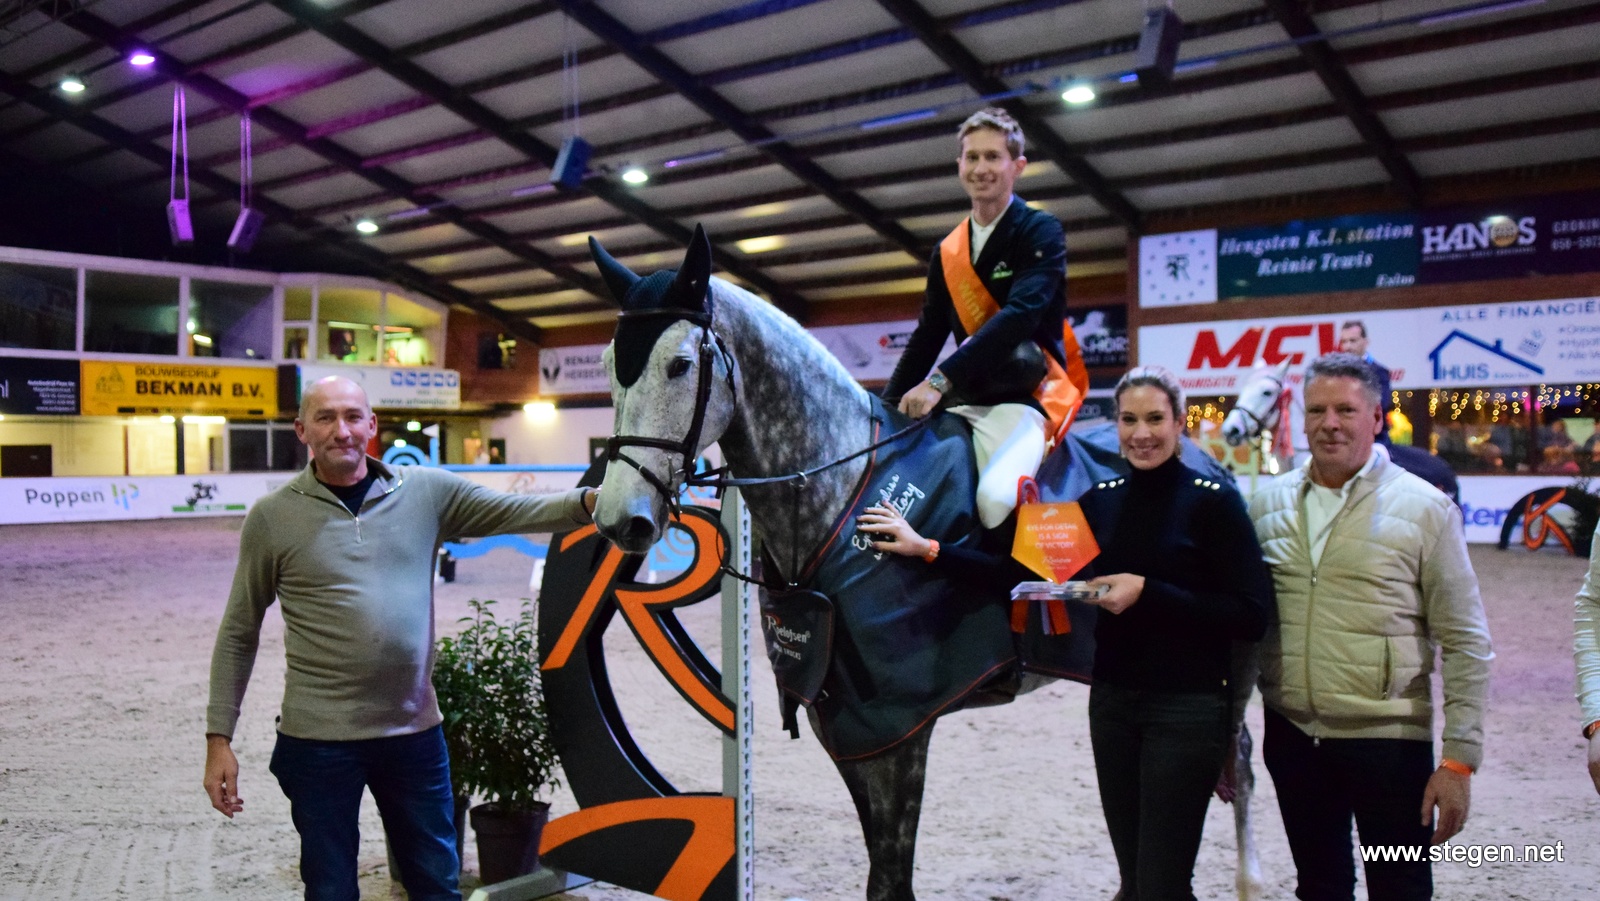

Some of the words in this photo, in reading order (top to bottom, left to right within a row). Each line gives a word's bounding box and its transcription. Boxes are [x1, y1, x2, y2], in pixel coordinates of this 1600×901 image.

[1219, 235, 1300, 256] Hengsten
[1347, 222, 1414, 243] station
[1257, 256, 1317, 277] Reinie
[1320, 251, 1374, 270] Tewis
[1442, 309, 1488, 321] ALLE
[1499, 300, 1600, 318] FINANCIË
[564, 355, 602, 366] RENAU
[135, 367, 220, 378] BOUWBEDRIJF
[136, 381, 222, 397] BEKMAN
[232, 383, 264, 398] B.V.
[25, 488, 104, 507] Poppen
